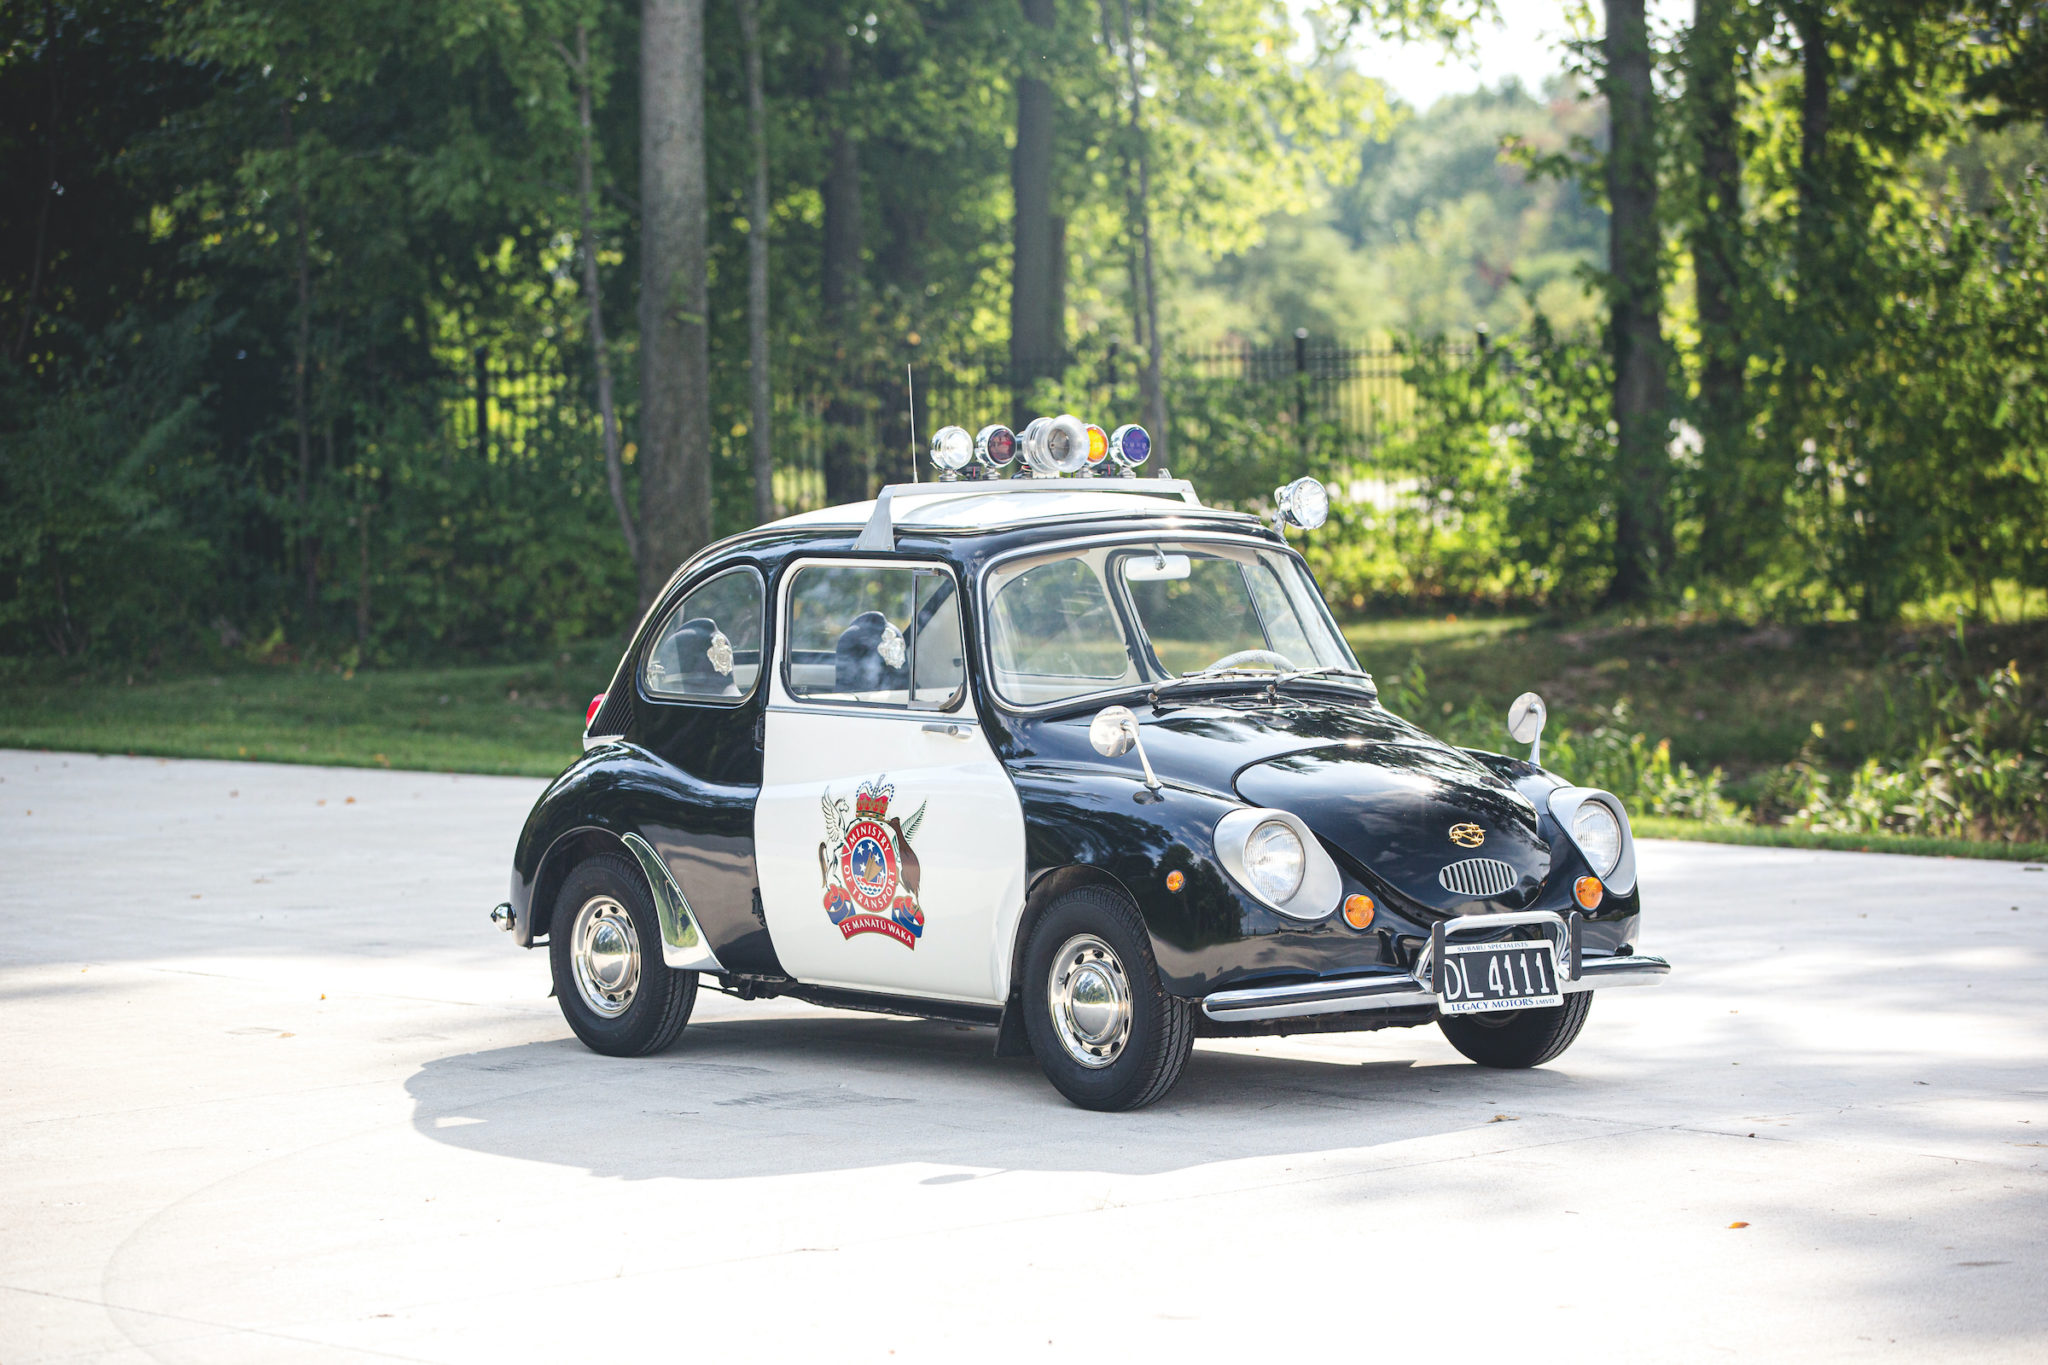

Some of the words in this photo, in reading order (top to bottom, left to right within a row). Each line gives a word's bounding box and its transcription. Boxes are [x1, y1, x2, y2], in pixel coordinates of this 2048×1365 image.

[849, 825, 891, 851] MINISTRY
[844, 865, 852, 882] OF
[852, 870, 895, 909] TRANSPORT
[842, 922, 851, 933] TE
[888, 923, 912, 944] WAKA
[1444, 958, 1484, 1000] DL
[1488, 952, 1550, 997] 4111
[1451, 1000, 1489, 1012] LEGACY
[1491, 998, 1534, 1010] MOTORS
